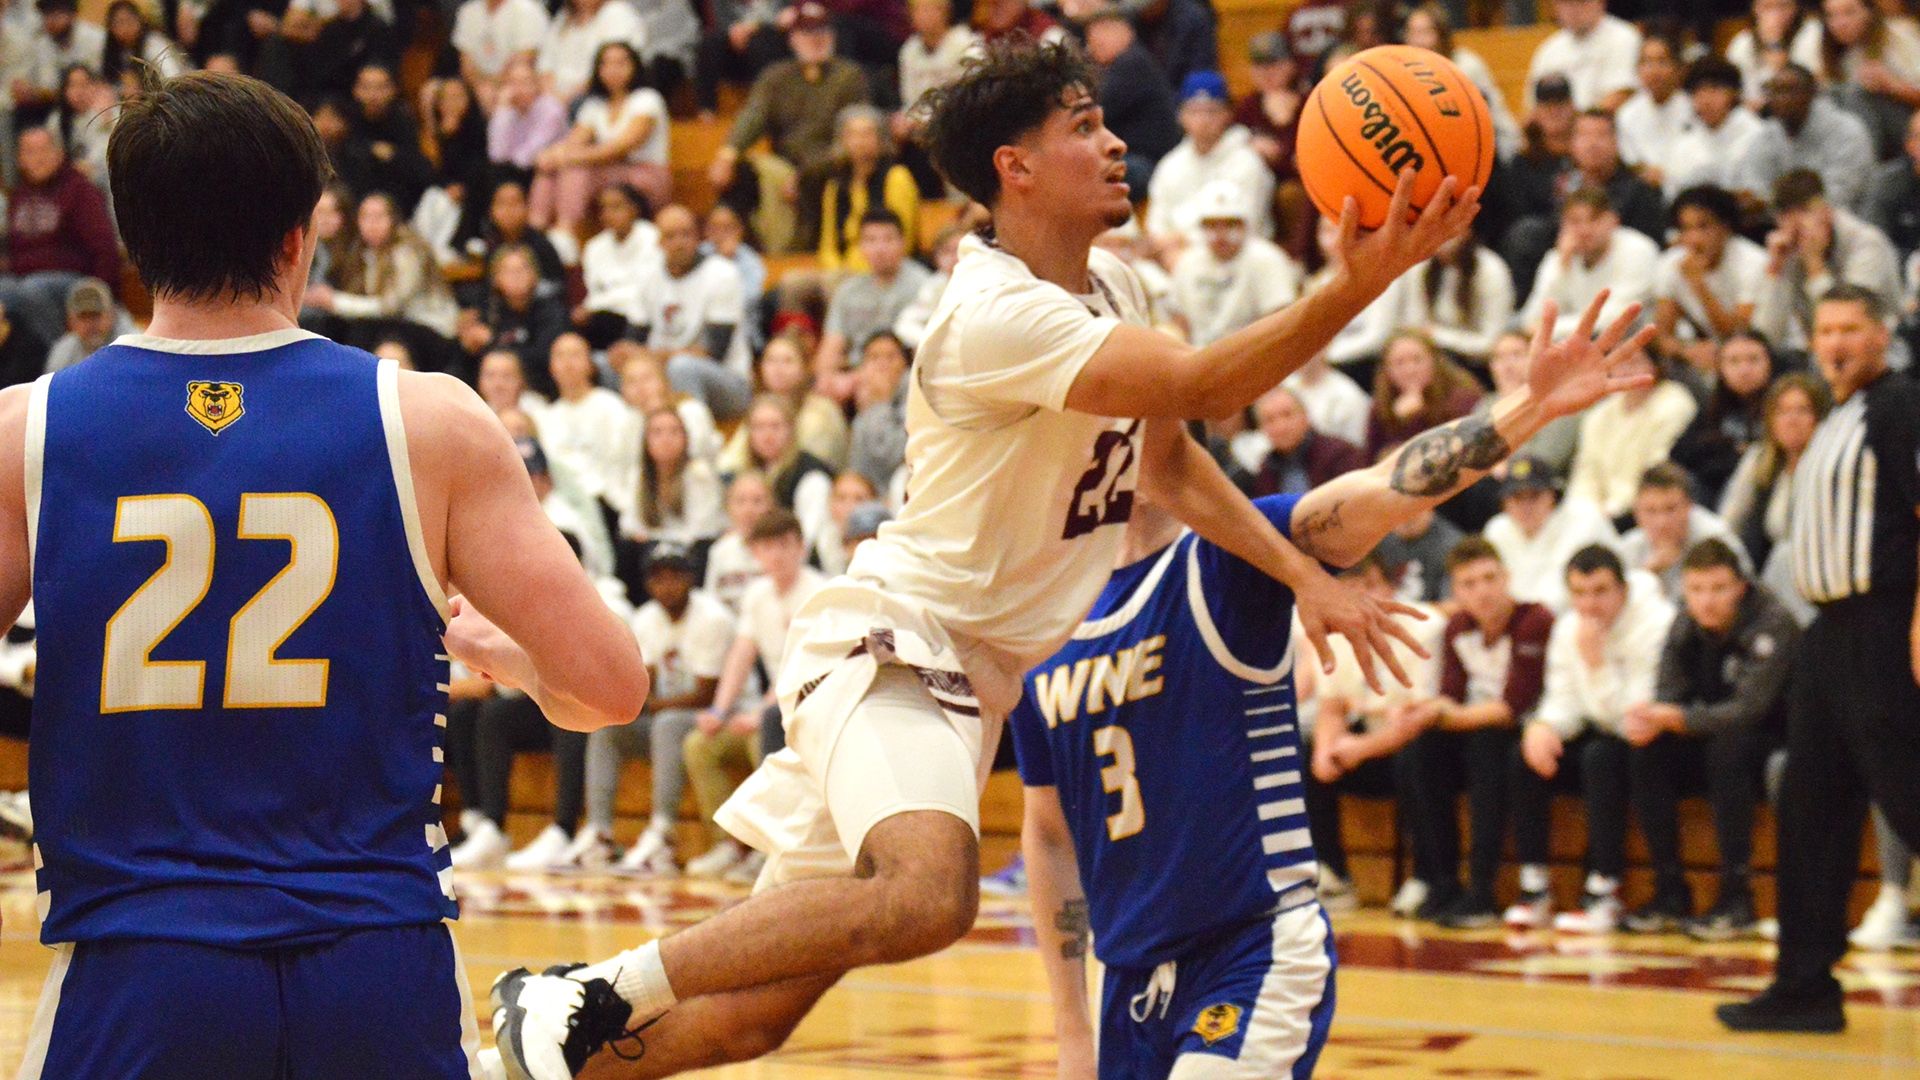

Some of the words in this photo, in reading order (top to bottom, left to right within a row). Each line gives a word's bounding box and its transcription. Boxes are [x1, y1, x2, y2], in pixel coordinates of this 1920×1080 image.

[1341, 72, 1425, 177] Wilson
[1061, 418, 1140, 540] 22
[100, 492, 339, 714] 22
[1034, 634, 1167, 729] WNE
[1093, 725, 1145, 841] 3
